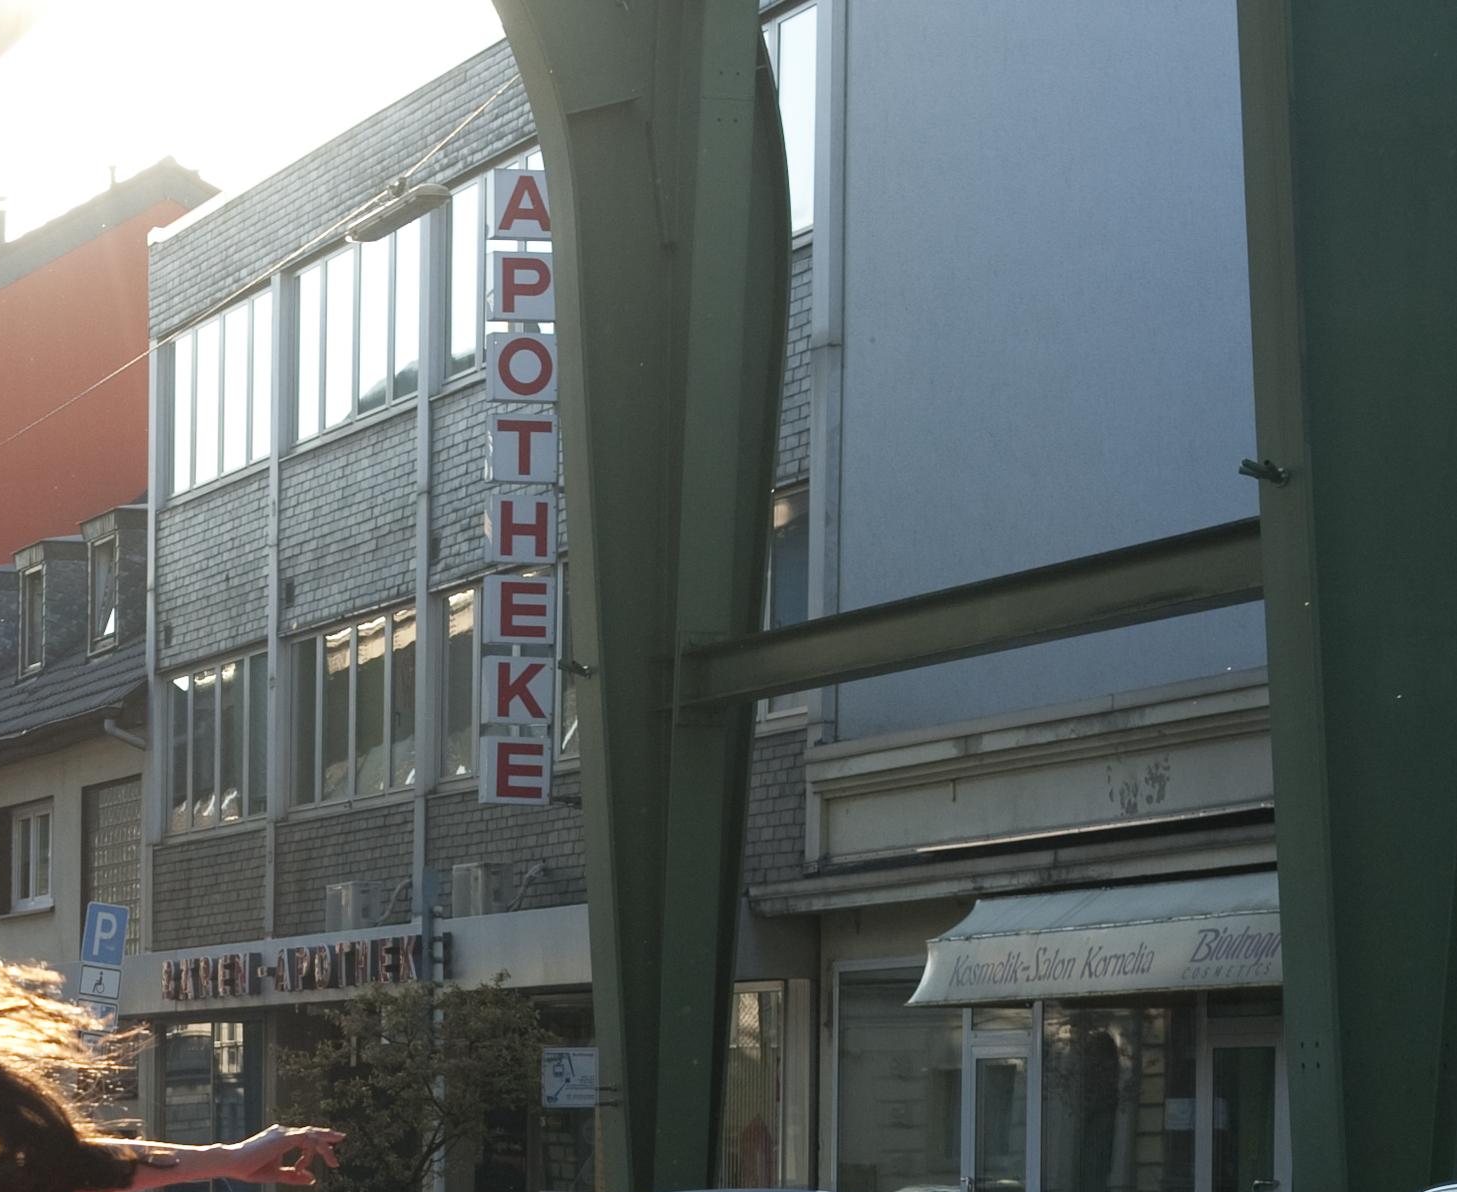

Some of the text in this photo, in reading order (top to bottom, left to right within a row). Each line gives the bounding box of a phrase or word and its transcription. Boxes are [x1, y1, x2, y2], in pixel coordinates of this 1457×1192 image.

[496, 175, 553, 799] APOTHEKE
[92, 911, 118, 956] P
[1080, 942, 1155, 980] Kornelia
[1181, 961, 1272, 980] COSMETICS
